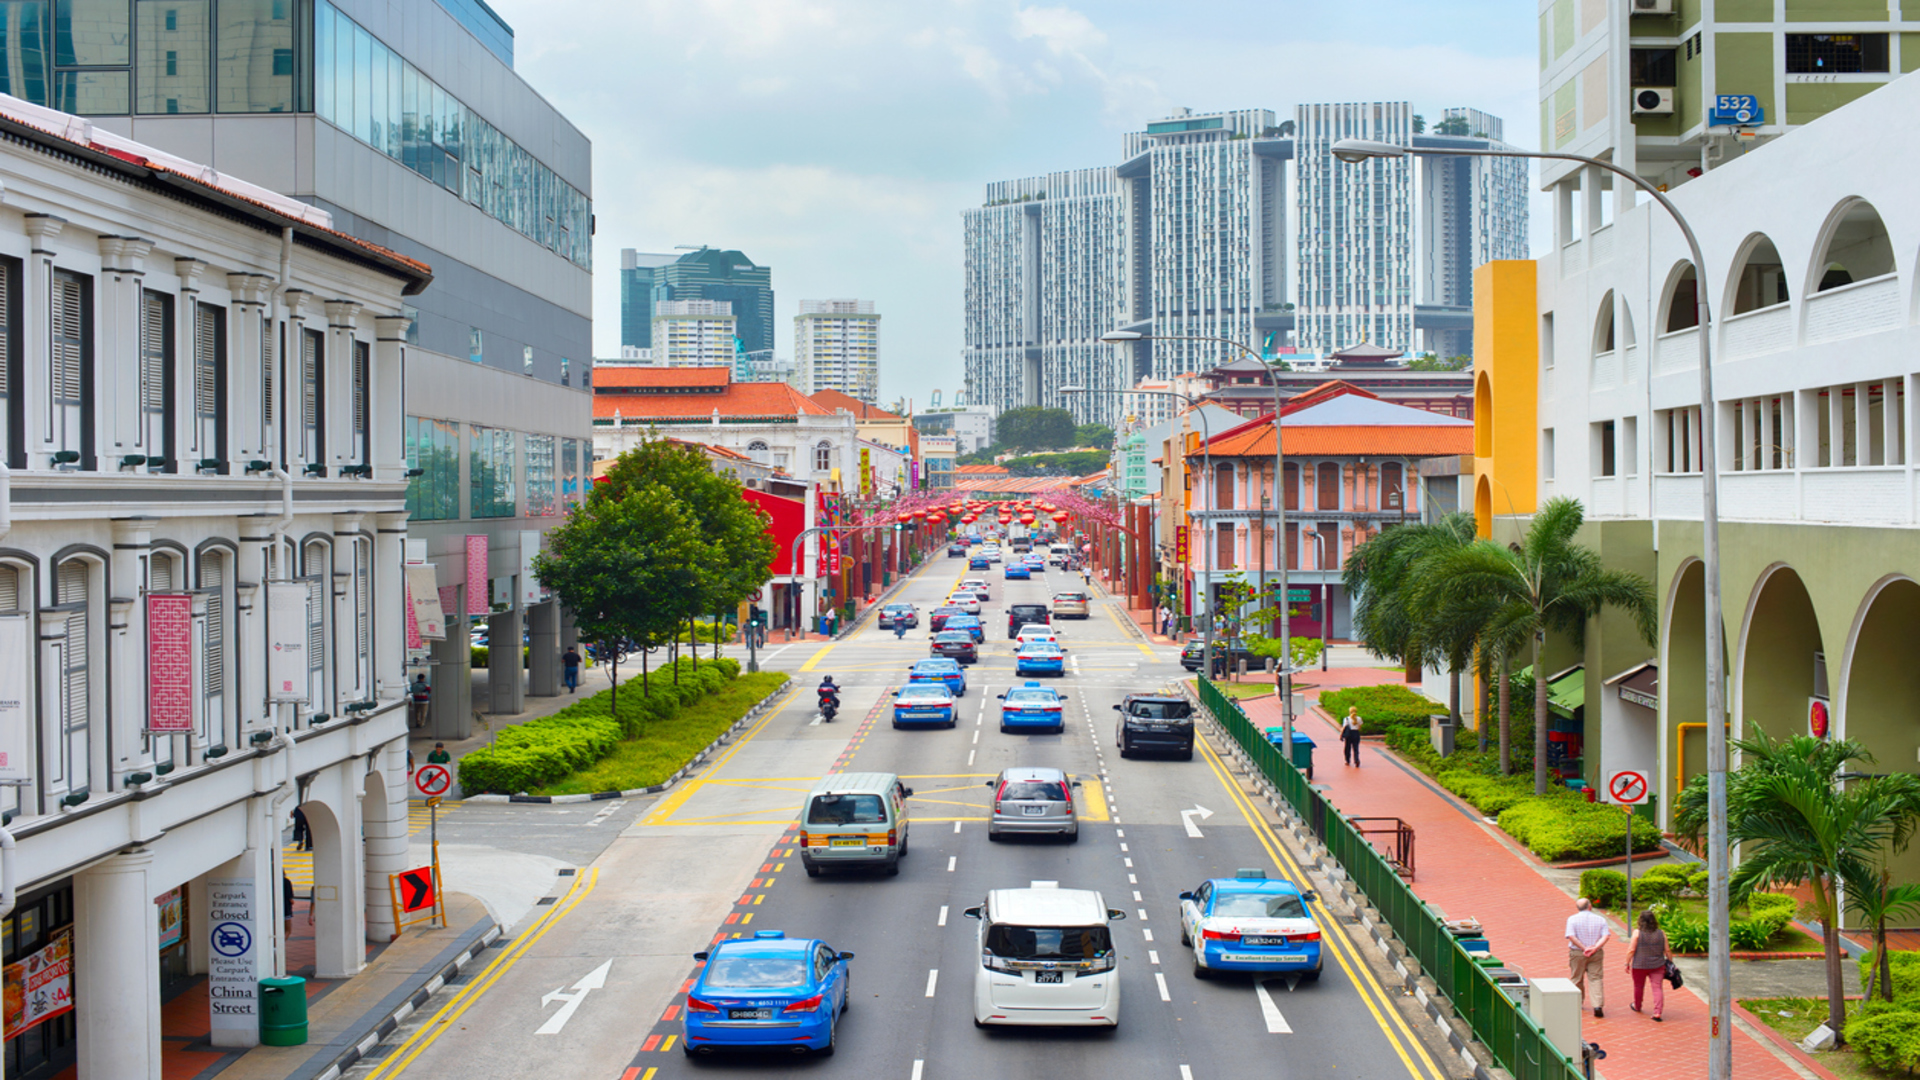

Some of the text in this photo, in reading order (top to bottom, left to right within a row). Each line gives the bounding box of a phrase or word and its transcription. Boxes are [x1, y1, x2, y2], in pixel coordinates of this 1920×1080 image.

[1720, 96, 1752, 110] 532
[213, 891, 247, 900] Carpark
[210, 909, 249, 920] Closed
[237, 957, 253, 965] Use
[216, 966, 250, 975] Carpark
[211, 986, 252, 998] China
[212, 1001, 252, 1014] Street
